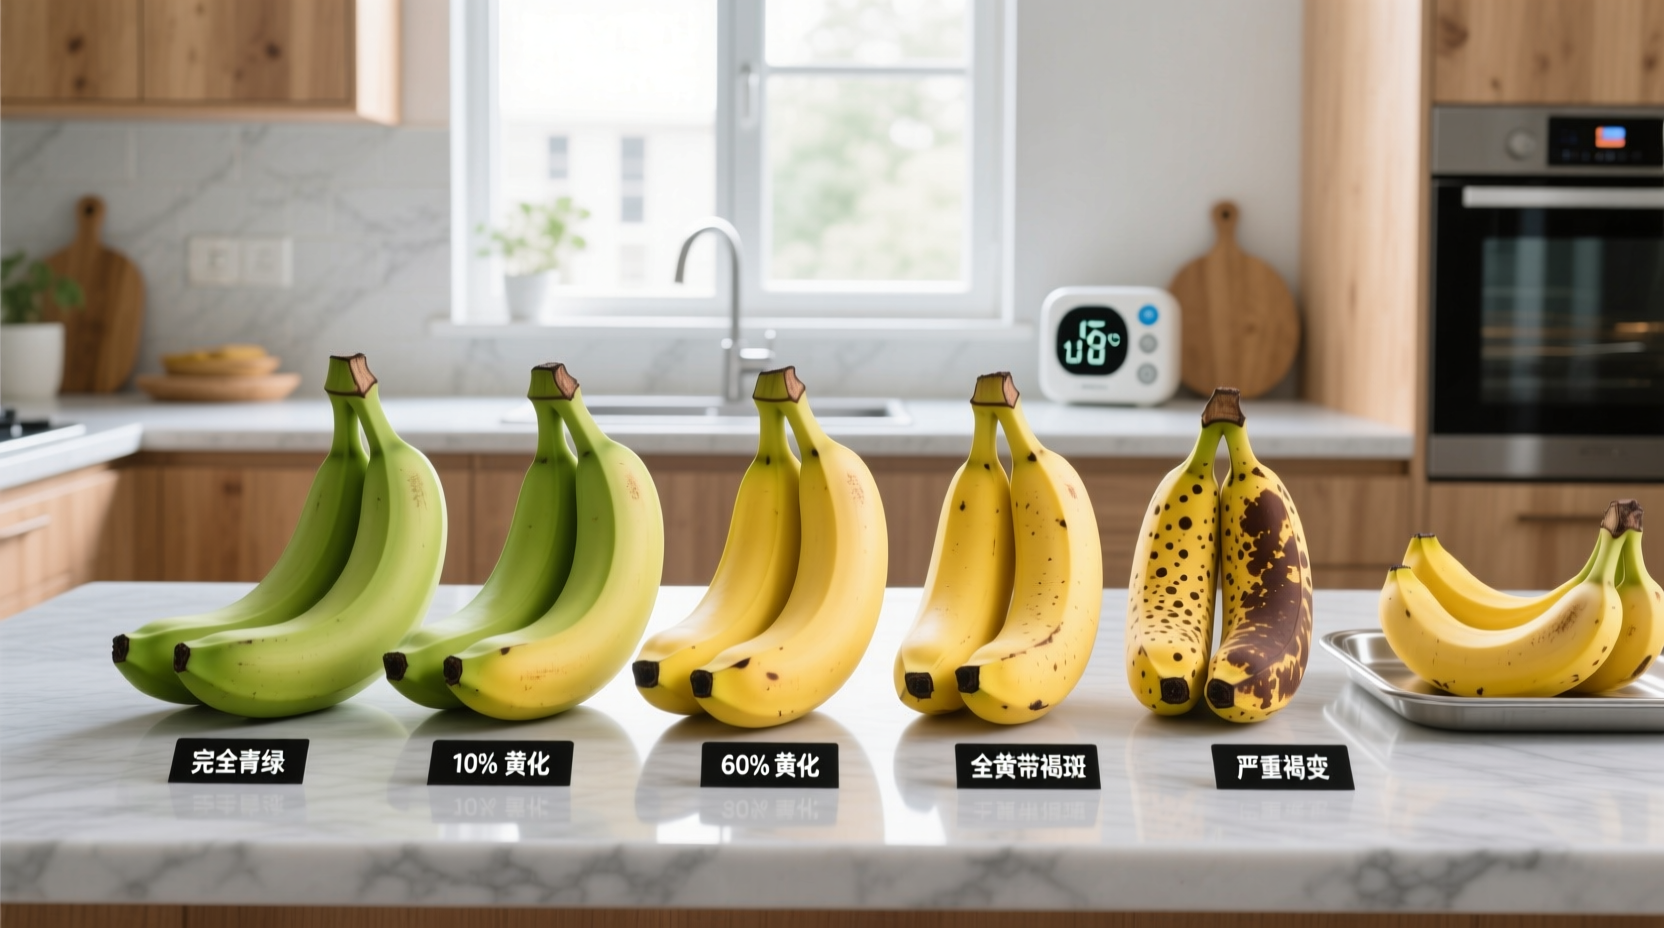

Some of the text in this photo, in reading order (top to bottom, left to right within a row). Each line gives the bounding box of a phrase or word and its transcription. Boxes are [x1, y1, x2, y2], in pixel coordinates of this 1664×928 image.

[191, 748, 286, 775] 完全青绿
[453, 750, 550, 777] 10% 黄化
[721, 751, 820, 778] 60% 黄化
[970, 752, 1087, 780] 全黄带褐斑
[1236, 753, 1330, 781] 严重褐变
